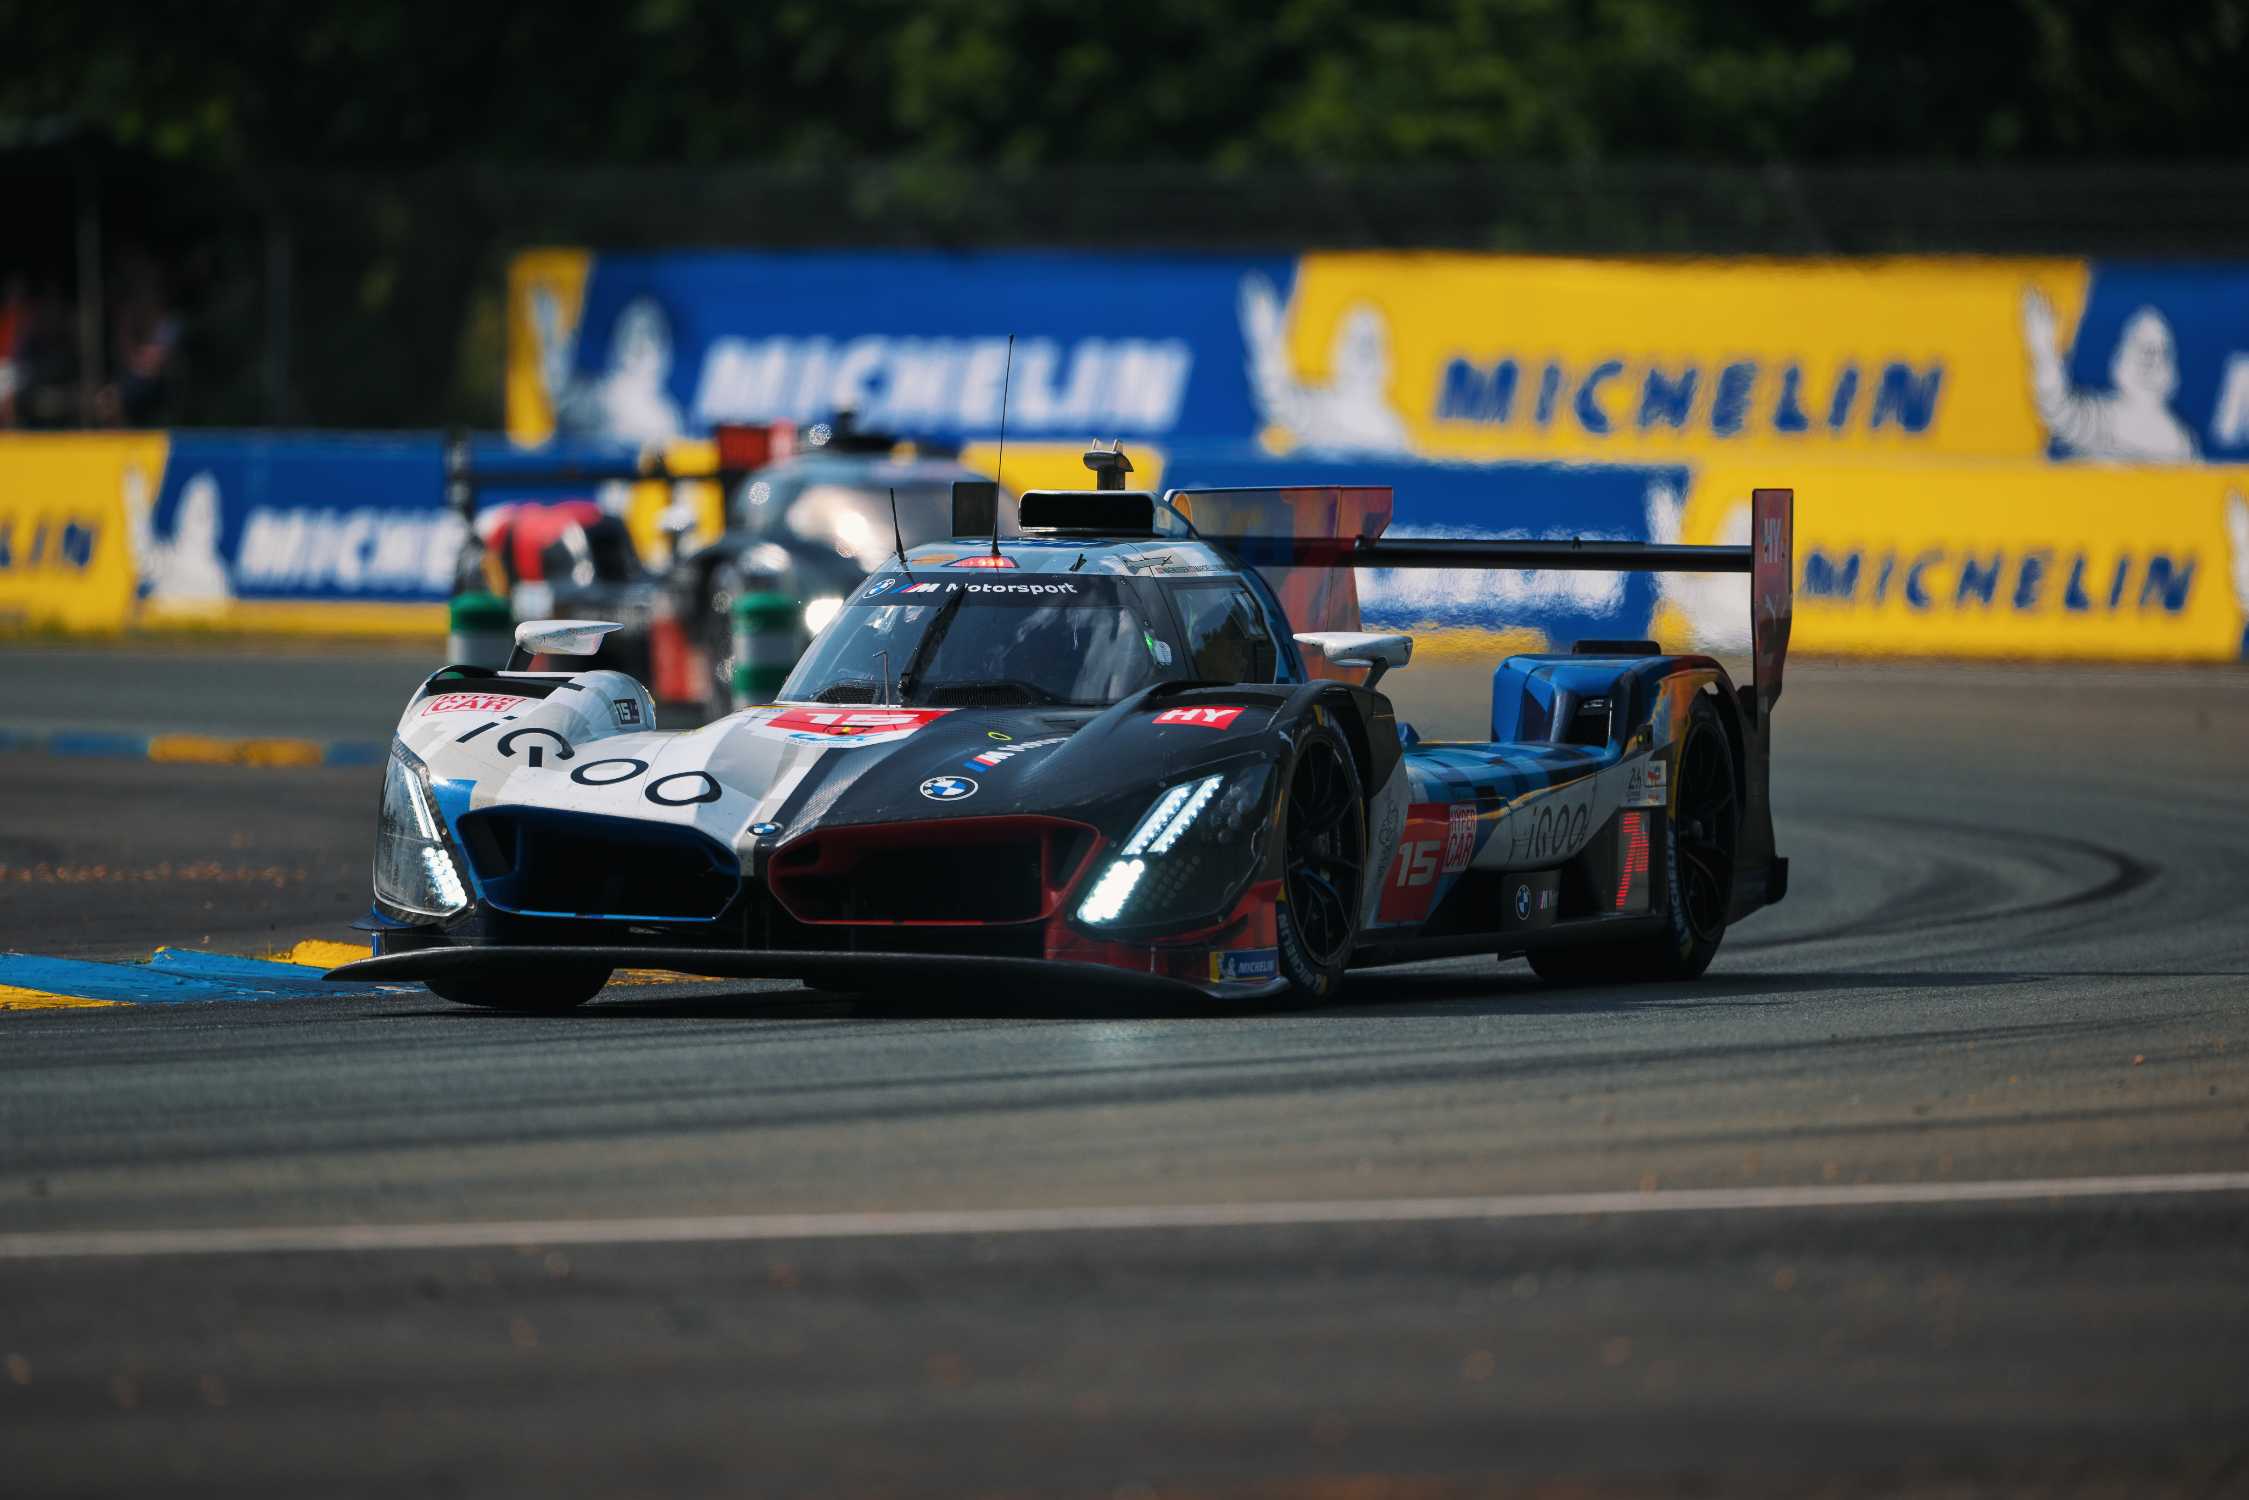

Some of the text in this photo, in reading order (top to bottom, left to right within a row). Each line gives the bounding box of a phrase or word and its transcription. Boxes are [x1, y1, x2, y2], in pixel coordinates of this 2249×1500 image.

[698, 336, 1192, 432] MICHELIN
[1435, 355, 1946, 436] MICHELIN
[1803, 548, 2196, 611] MICHELIN
[945, 582, 1078, 595] Motorsport
[431, 697, 509, 712] CAR
[806, 713, 920, 727] 15
[1161, 708, 1238, 723] HY
[1396, 840, 1441, 888] 15
[1238, 959, 1275, 974] MICHELIN
